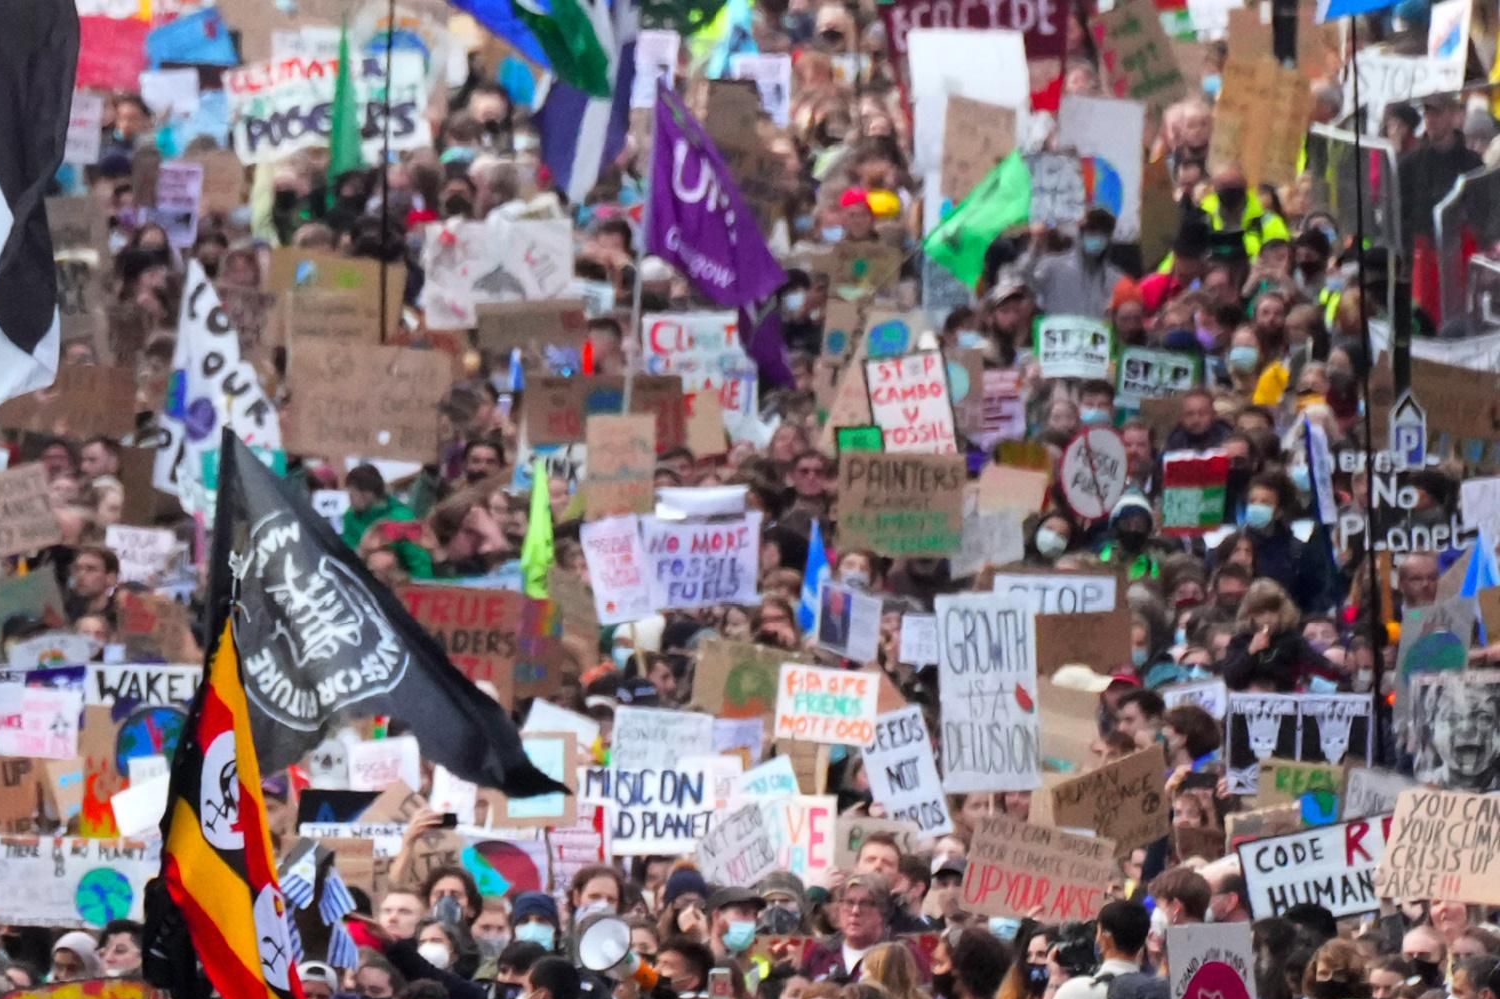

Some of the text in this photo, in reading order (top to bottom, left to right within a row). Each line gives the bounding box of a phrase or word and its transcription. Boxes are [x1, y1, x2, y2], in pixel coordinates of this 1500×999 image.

[228, 57, 342, 93] CLIMAT
[245, 102, 418, 154] POGGRS
[846, 457, 958, 494] PAINTERS
[945, 607, 1029, 677] GROWTH
[96, 669, 187, 705] WAKE
[942, 721, 1040, 773] DELUSION
[585, 769, 705, 808] MUSIC ON
[885, 757, 921, 796] NOT
[642, 809, 713, 841] PLANET
[1413, 794, 1458, 824] YOU
[1397, 818, 1451, 852] YOUR
[1254, 835, 1323, 873] CODE
[1390, 847, 1494, 882] CRISIS UP
[963, 865, 1006, 906] UP
